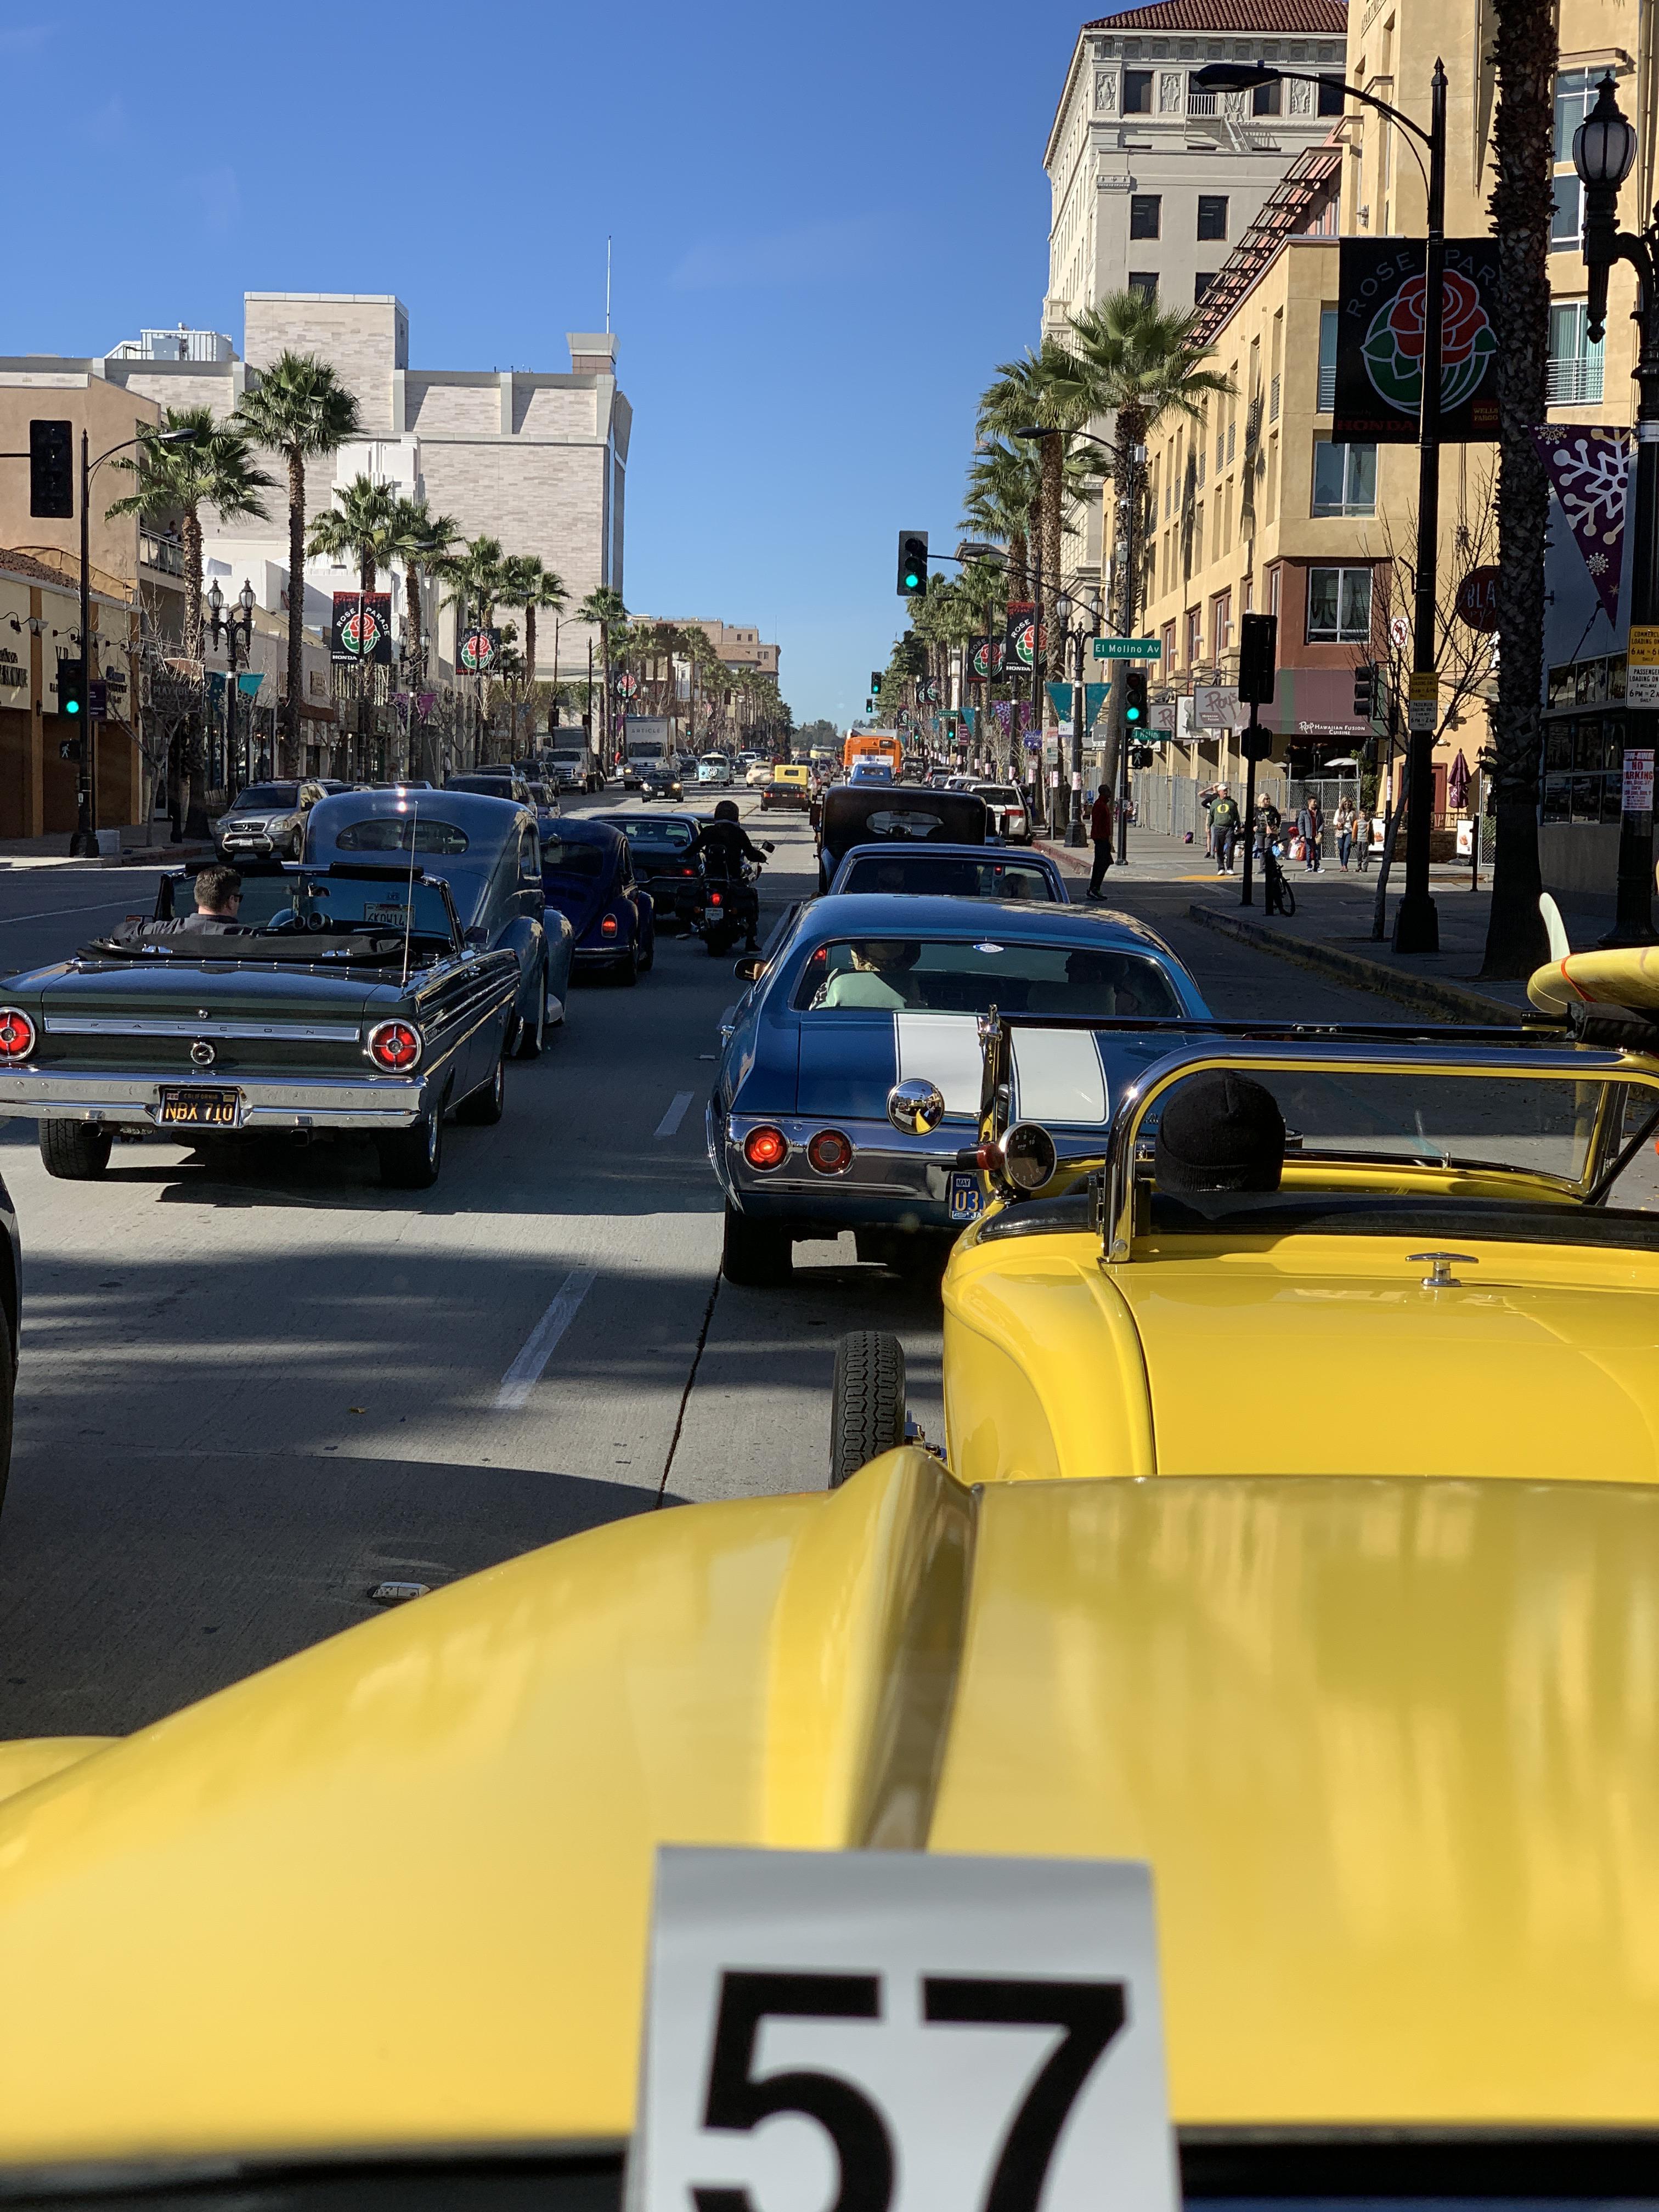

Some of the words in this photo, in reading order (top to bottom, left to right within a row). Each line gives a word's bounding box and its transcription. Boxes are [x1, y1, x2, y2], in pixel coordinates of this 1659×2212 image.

[1346, 251, 1415, 318] ROSE
[1338, 420, 1414, 431] HONDA
[336, 608, 356, 627] ROSE
[365, 607, 390, 636] PARADE
[1011, 619, 1031, 639] ROSE
[969, 638, 987, 654] ROSE
[1109, 645, 1142, 653] Molino
[1632, 761, 1644, 770] NO
[91, 1023, 314, 1035] FALCON
[166, 1102, 198, 1120] NBX
[205, 1103, 233, 1121] 710
[685, 1970, 1132, 2212] 57
